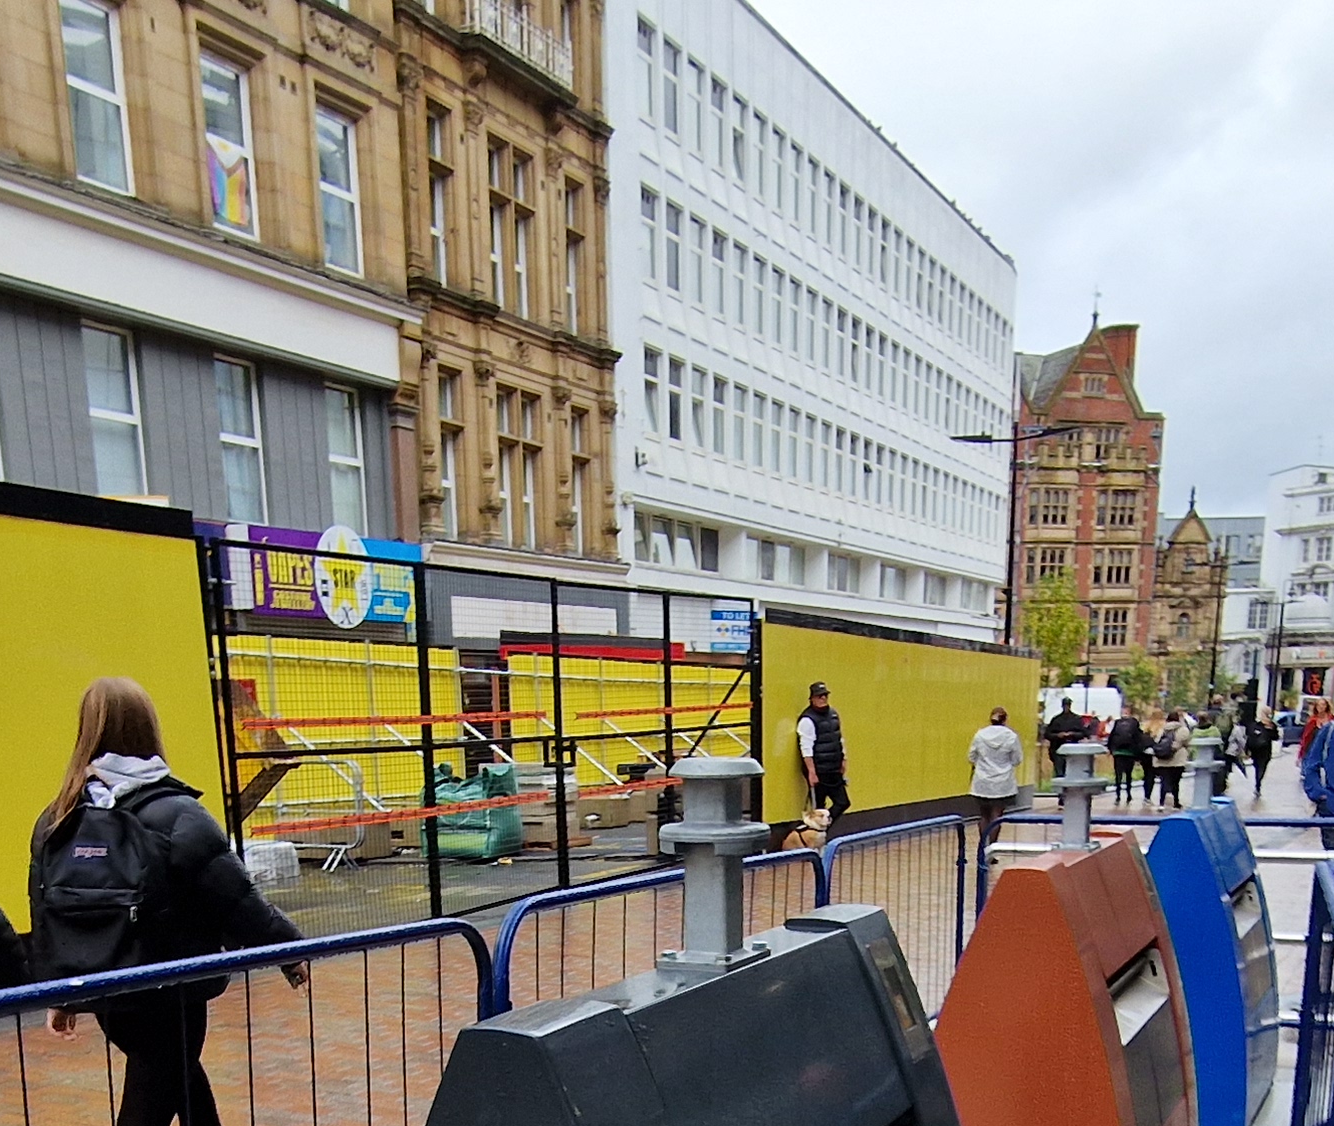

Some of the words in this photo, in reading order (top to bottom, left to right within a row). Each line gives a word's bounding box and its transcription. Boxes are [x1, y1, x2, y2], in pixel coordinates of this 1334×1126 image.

[332, 568, 356, 589] STAR
[722, 612, 734, 620] TO
[735, 612, 750, 621] LET
